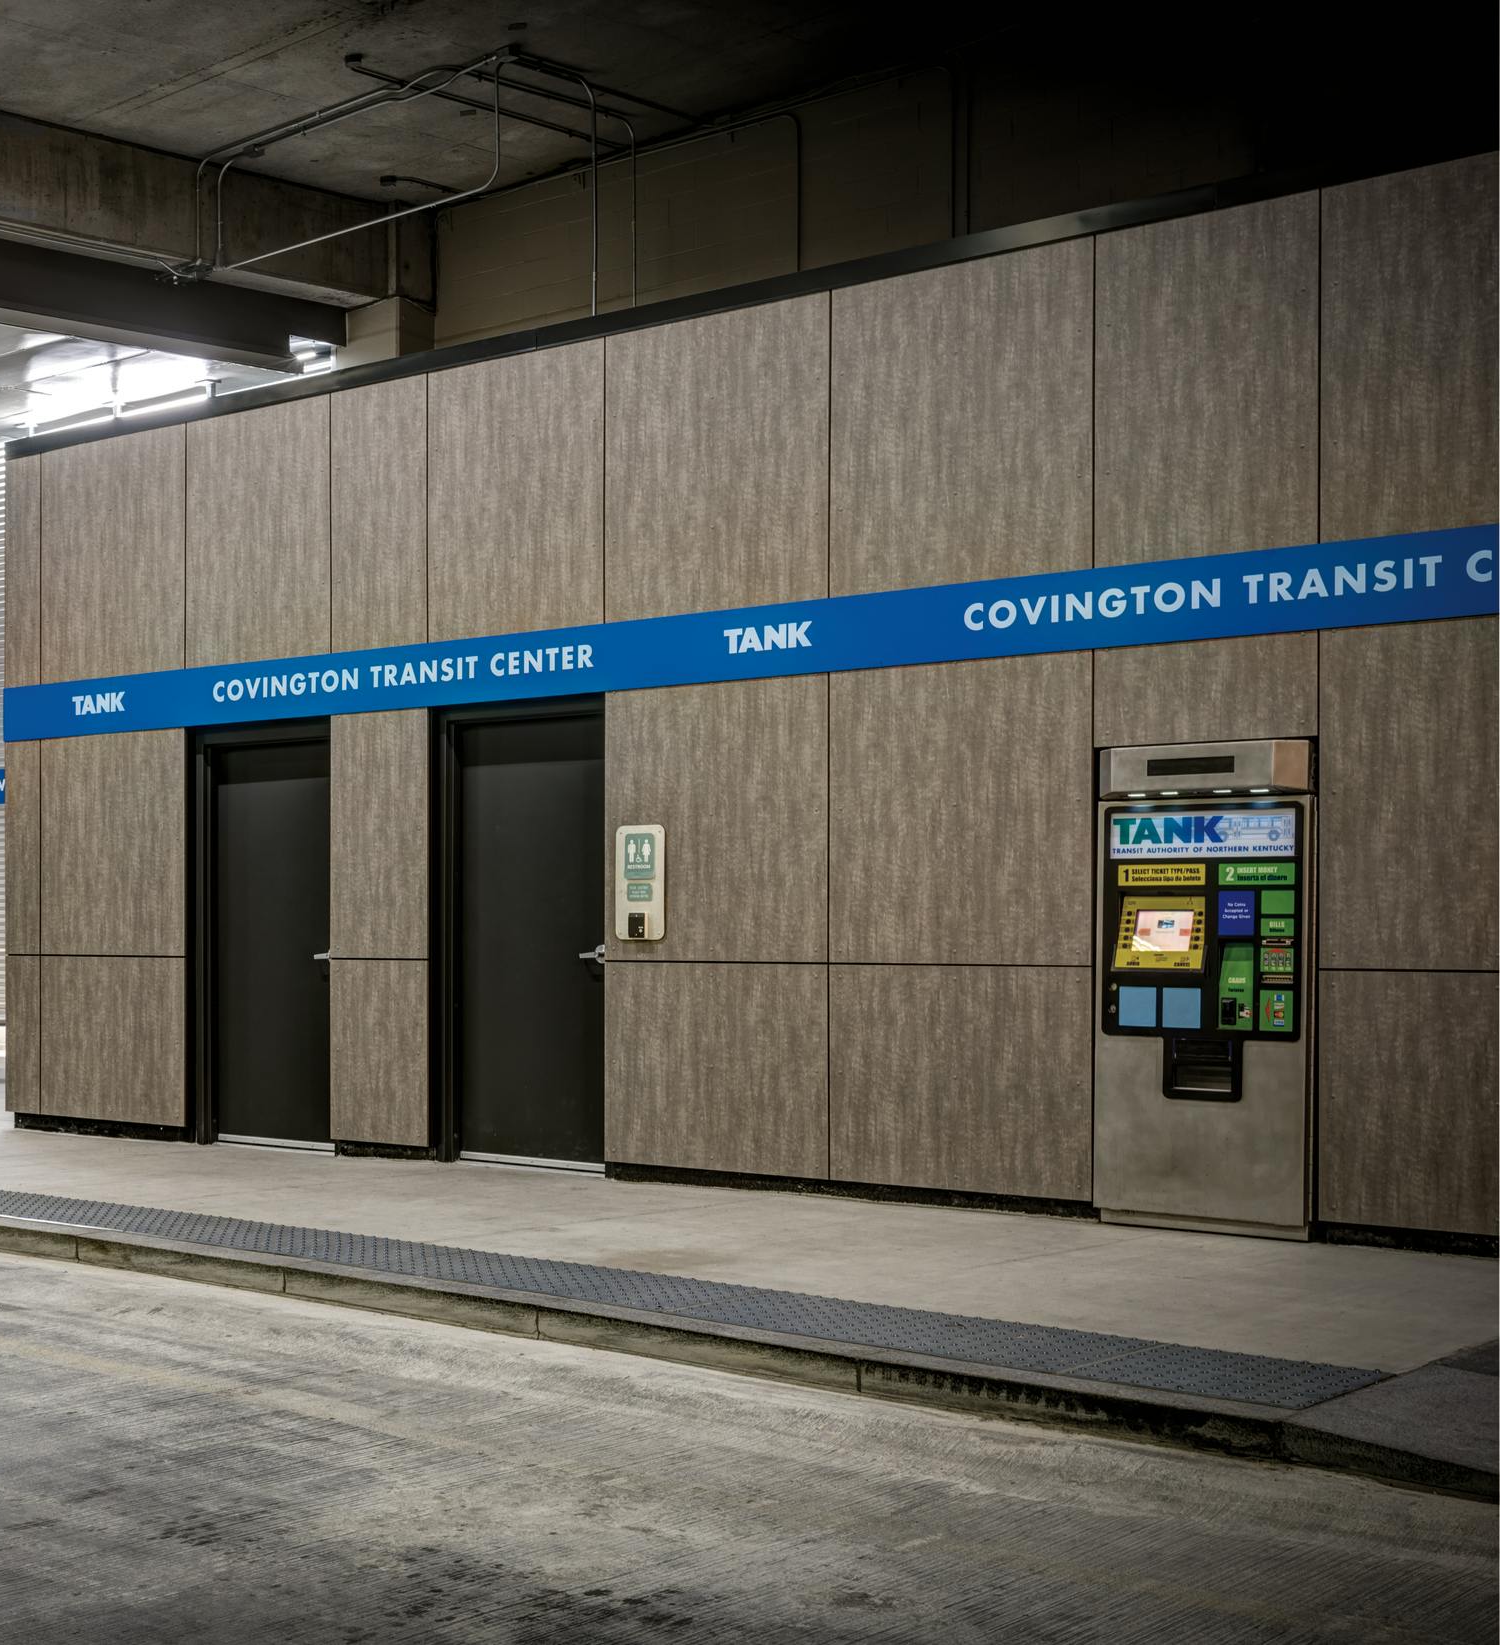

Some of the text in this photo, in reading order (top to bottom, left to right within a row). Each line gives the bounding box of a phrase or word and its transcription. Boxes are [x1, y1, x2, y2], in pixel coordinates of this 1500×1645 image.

[722, 619, 813, 655] TANK
[962, 577, 1222, 632] COVINGTON
[1241, 553, 1443, 605] TRANSIT
[72, 643, 595, 717] TANK COVINGTON TRANSIT CENTER
[1112, 815, 1224, 845] TANK
[1112, 847, 1143, 855] TRANSIT
[1147, 846, 1189, 854] AUTHORITY
[1206, 845, 1249, 853] NORTHERN
[1123, 868, 1129, 882] 1
[1225, 866, 1235, 882] 2
